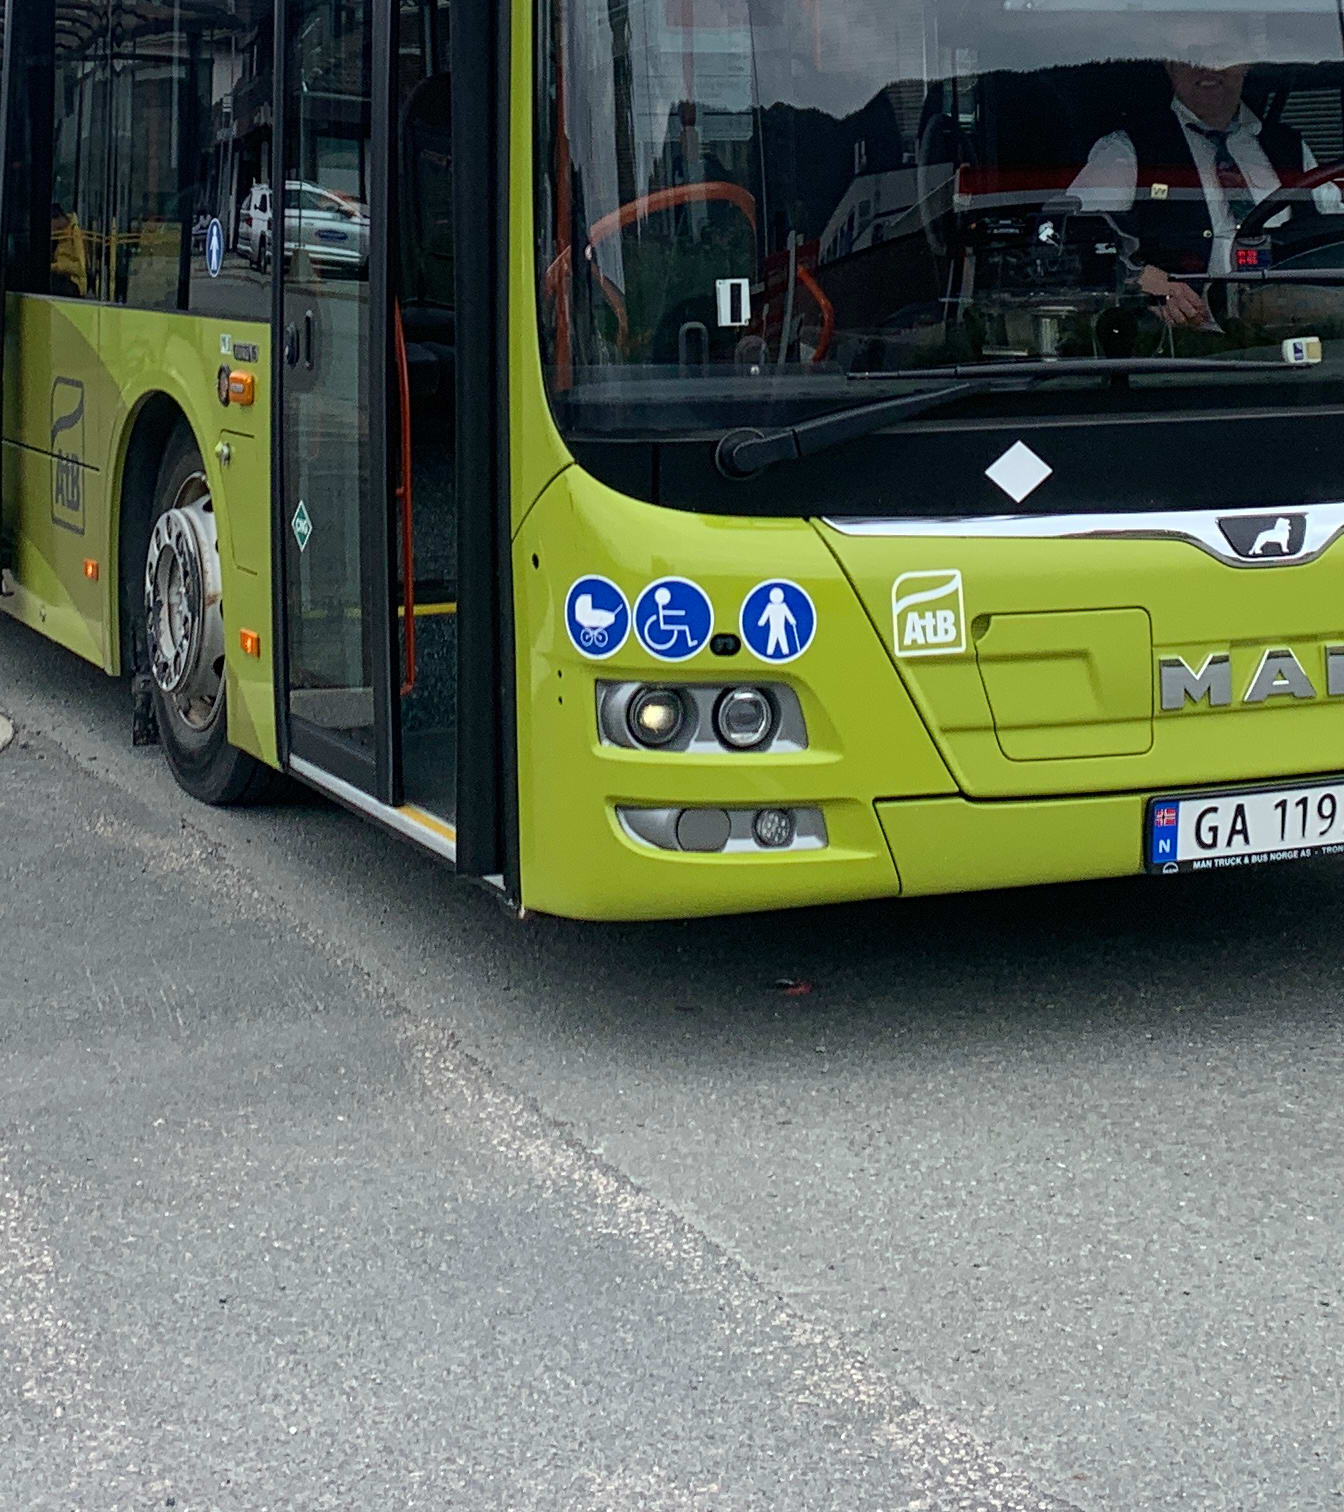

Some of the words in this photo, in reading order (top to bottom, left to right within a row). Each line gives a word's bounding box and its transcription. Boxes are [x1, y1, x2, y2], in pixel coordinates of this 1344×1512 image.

[903, 609, 957, 645] AtB
[1195, 802, 1251, 851] GA
[1158, 838, 1171, 854] N
[1192, 859, 1212, 869] MAN
[1214, 855, 1242, 867] TRUCK
[1251, 852, 1268, 863] BUS
[1269, 849, 1299, 862] NORGE
[1300, 848, 1312, 858] AS
